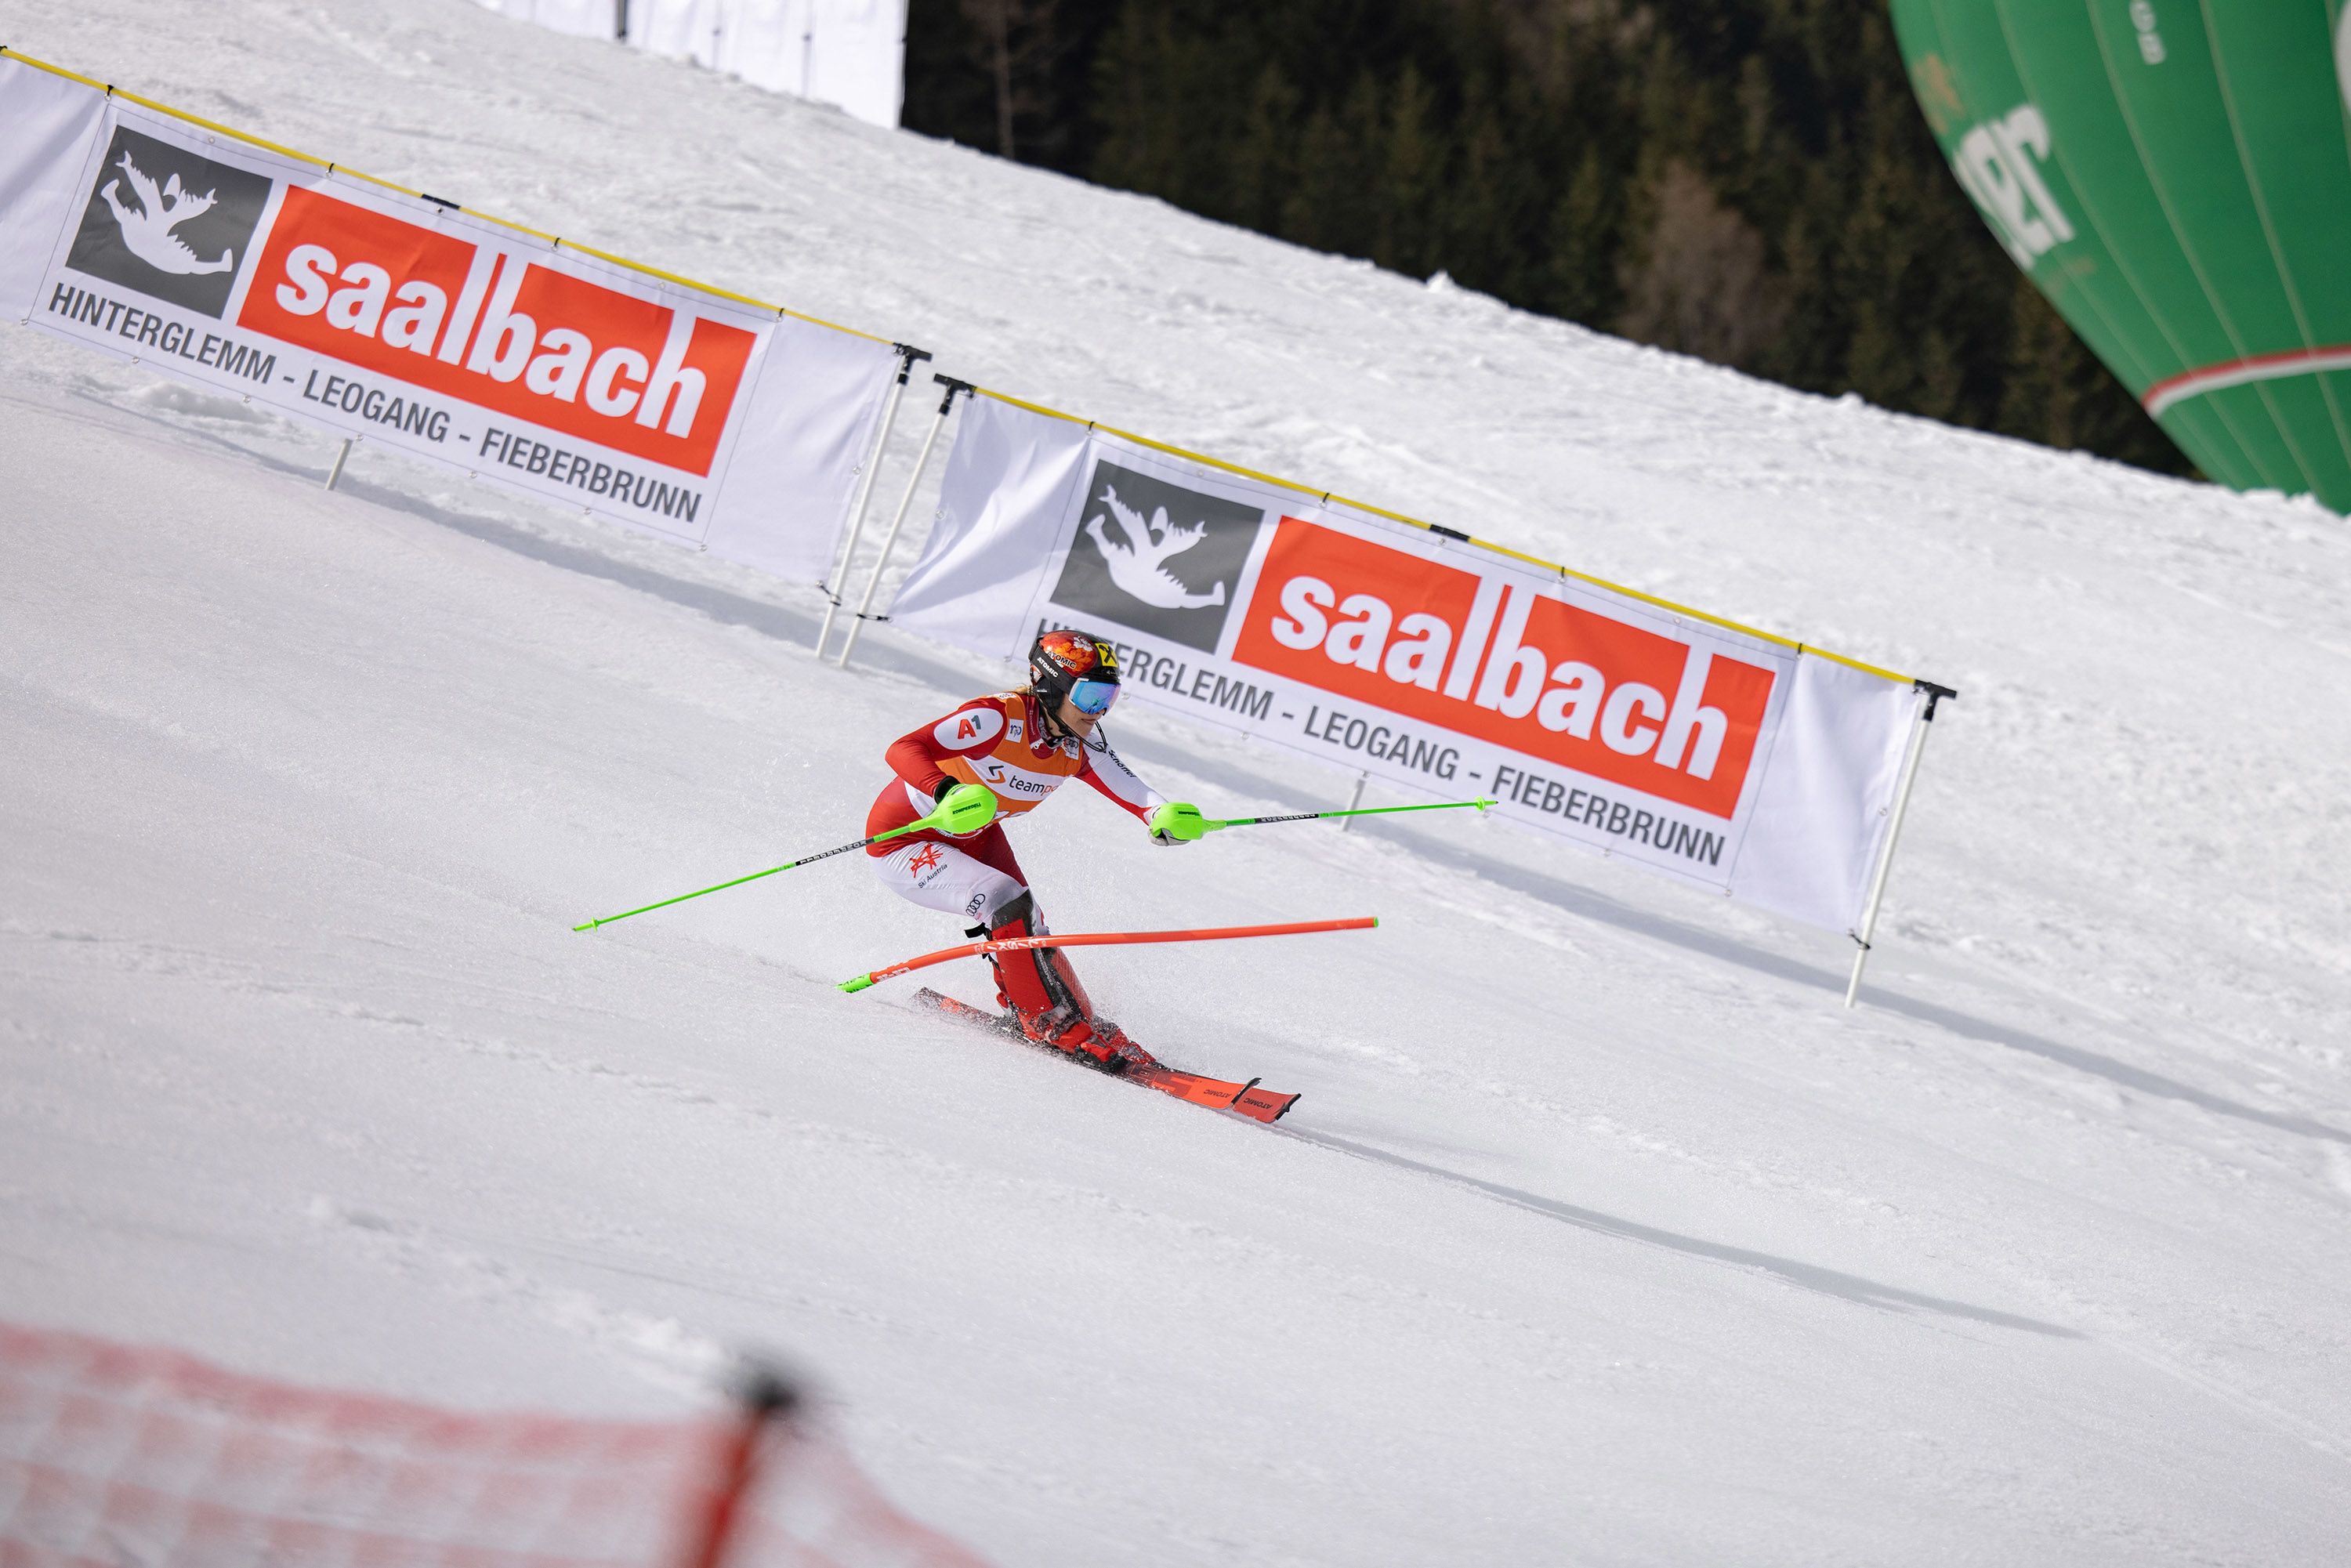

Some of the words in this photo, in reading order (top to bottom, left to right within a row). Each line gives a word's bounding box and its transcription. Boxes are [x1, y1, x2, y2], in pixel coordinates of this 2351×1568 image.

[274, 246, 708, 438] saalbach
[51, 283, 277, 384] HINTERGLEMM
[304, 370, 451, 442] LEOGANG
[480, 428, 701, 523] FIEBERBRUNN
[1037, 657, 1059, 678] ATOMIC
[1047, 651, 1077, 669] ATOMIC
[1271, 578, 1727, 780] saalbach
[957, 715, 981, 740] A1
[1305, 706, 1459, 780] LEOGANG
[1492, 766, 1725, 866] FIEBERBRUNN
[952, 802, 982, 815] KOMPERDELL
[799, 840, 868, 865] KOMPERDELL
[918, 879, 927, 889] Ski
[926, 863, 947, 883] Austria
[1204, 1088, 1232, 1099] ATOMIC
[1244, 1097, 1273, 1110] ATOMIC
